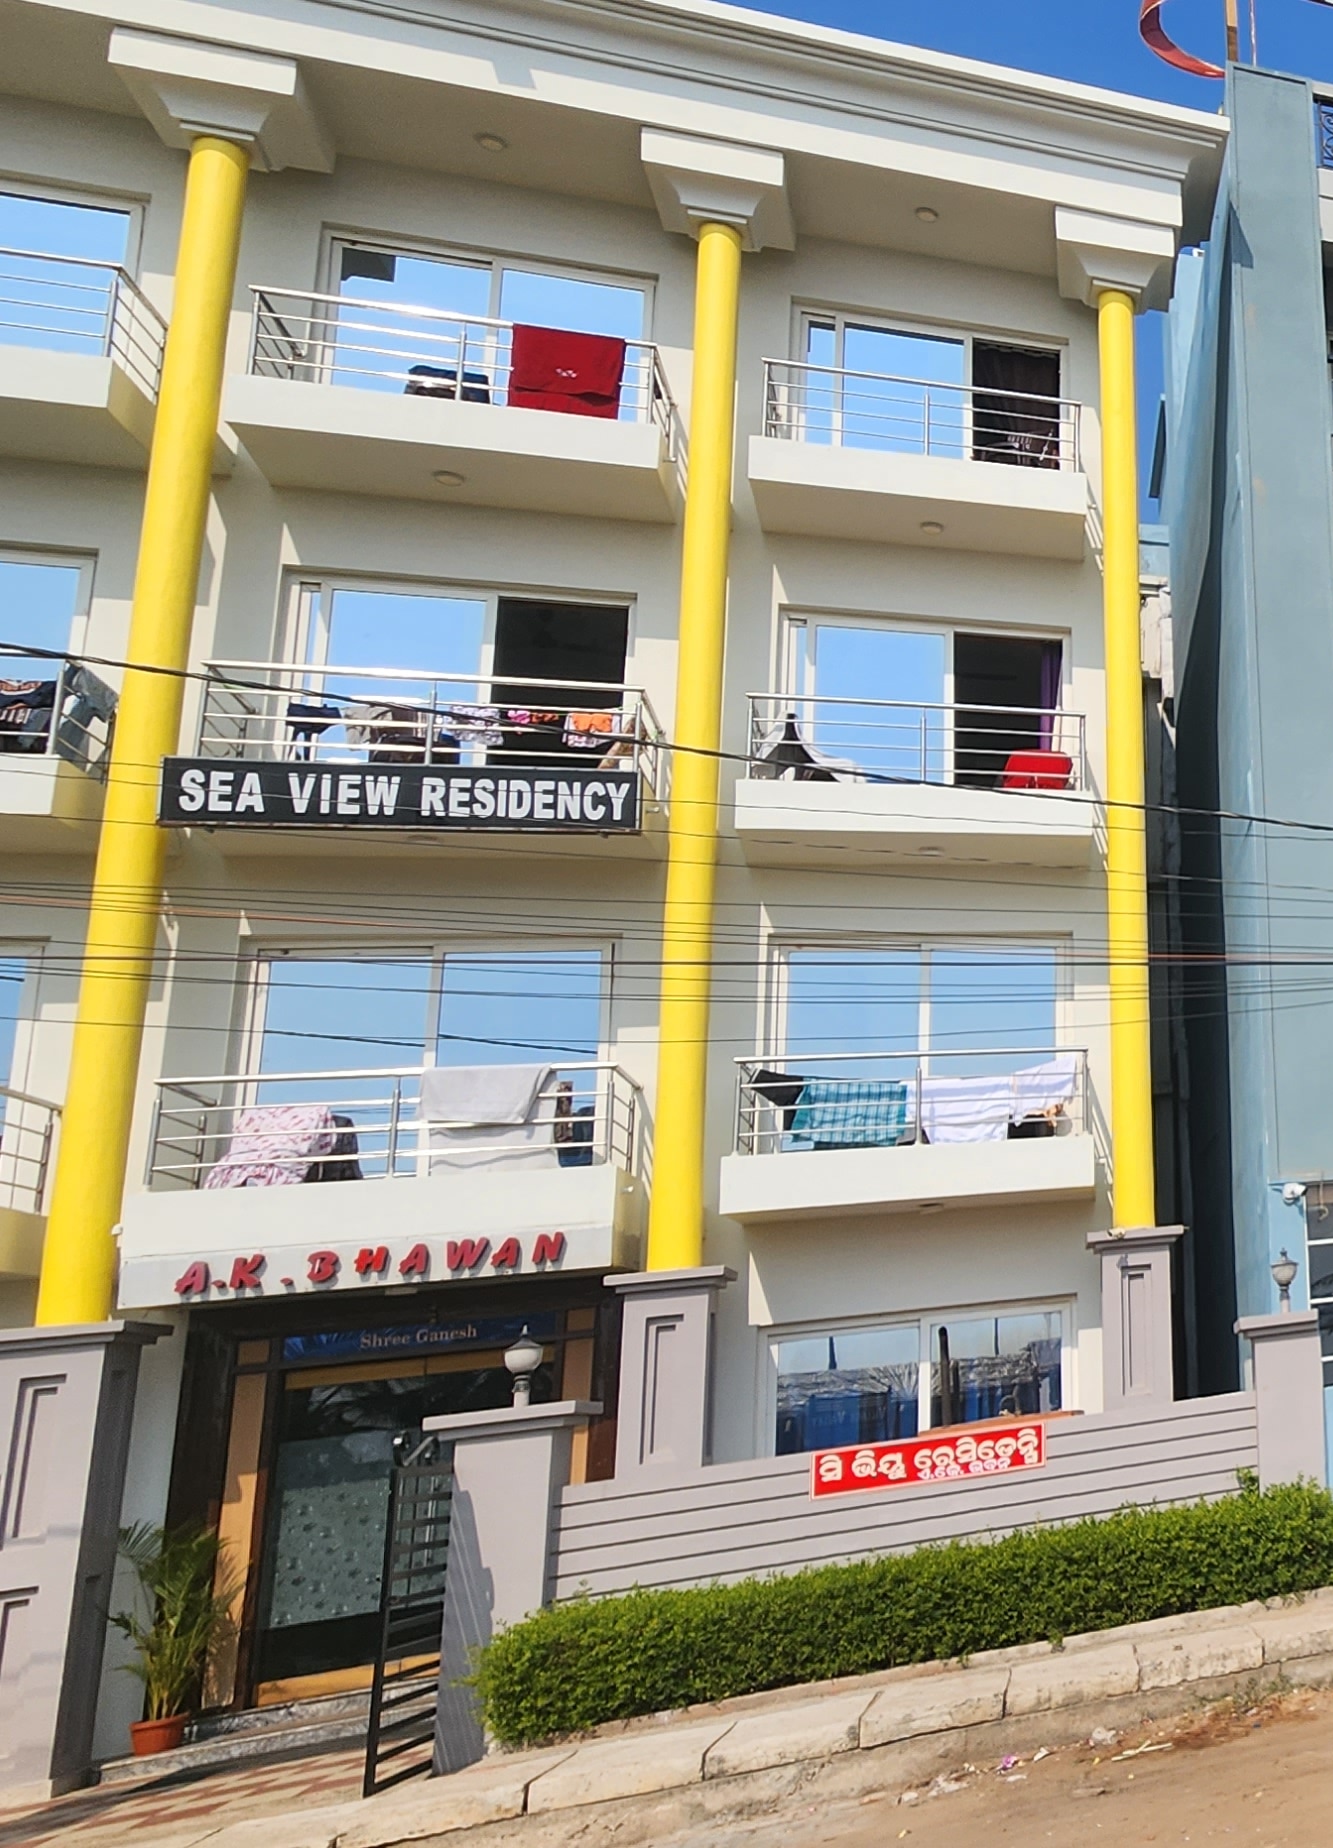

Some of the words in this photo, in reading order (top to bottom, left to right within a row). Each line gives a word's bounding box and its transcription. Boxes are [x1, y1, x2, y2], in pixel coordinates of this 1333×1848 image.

[178, 769, 265, 814] SEA
[288, 773, 401, 817] VIEW
[420, 776, 631, 821] RESIDENCY
[360, 1331, 411, 1350] Shree
[416, 1323, 478, 1345] Ganesh
